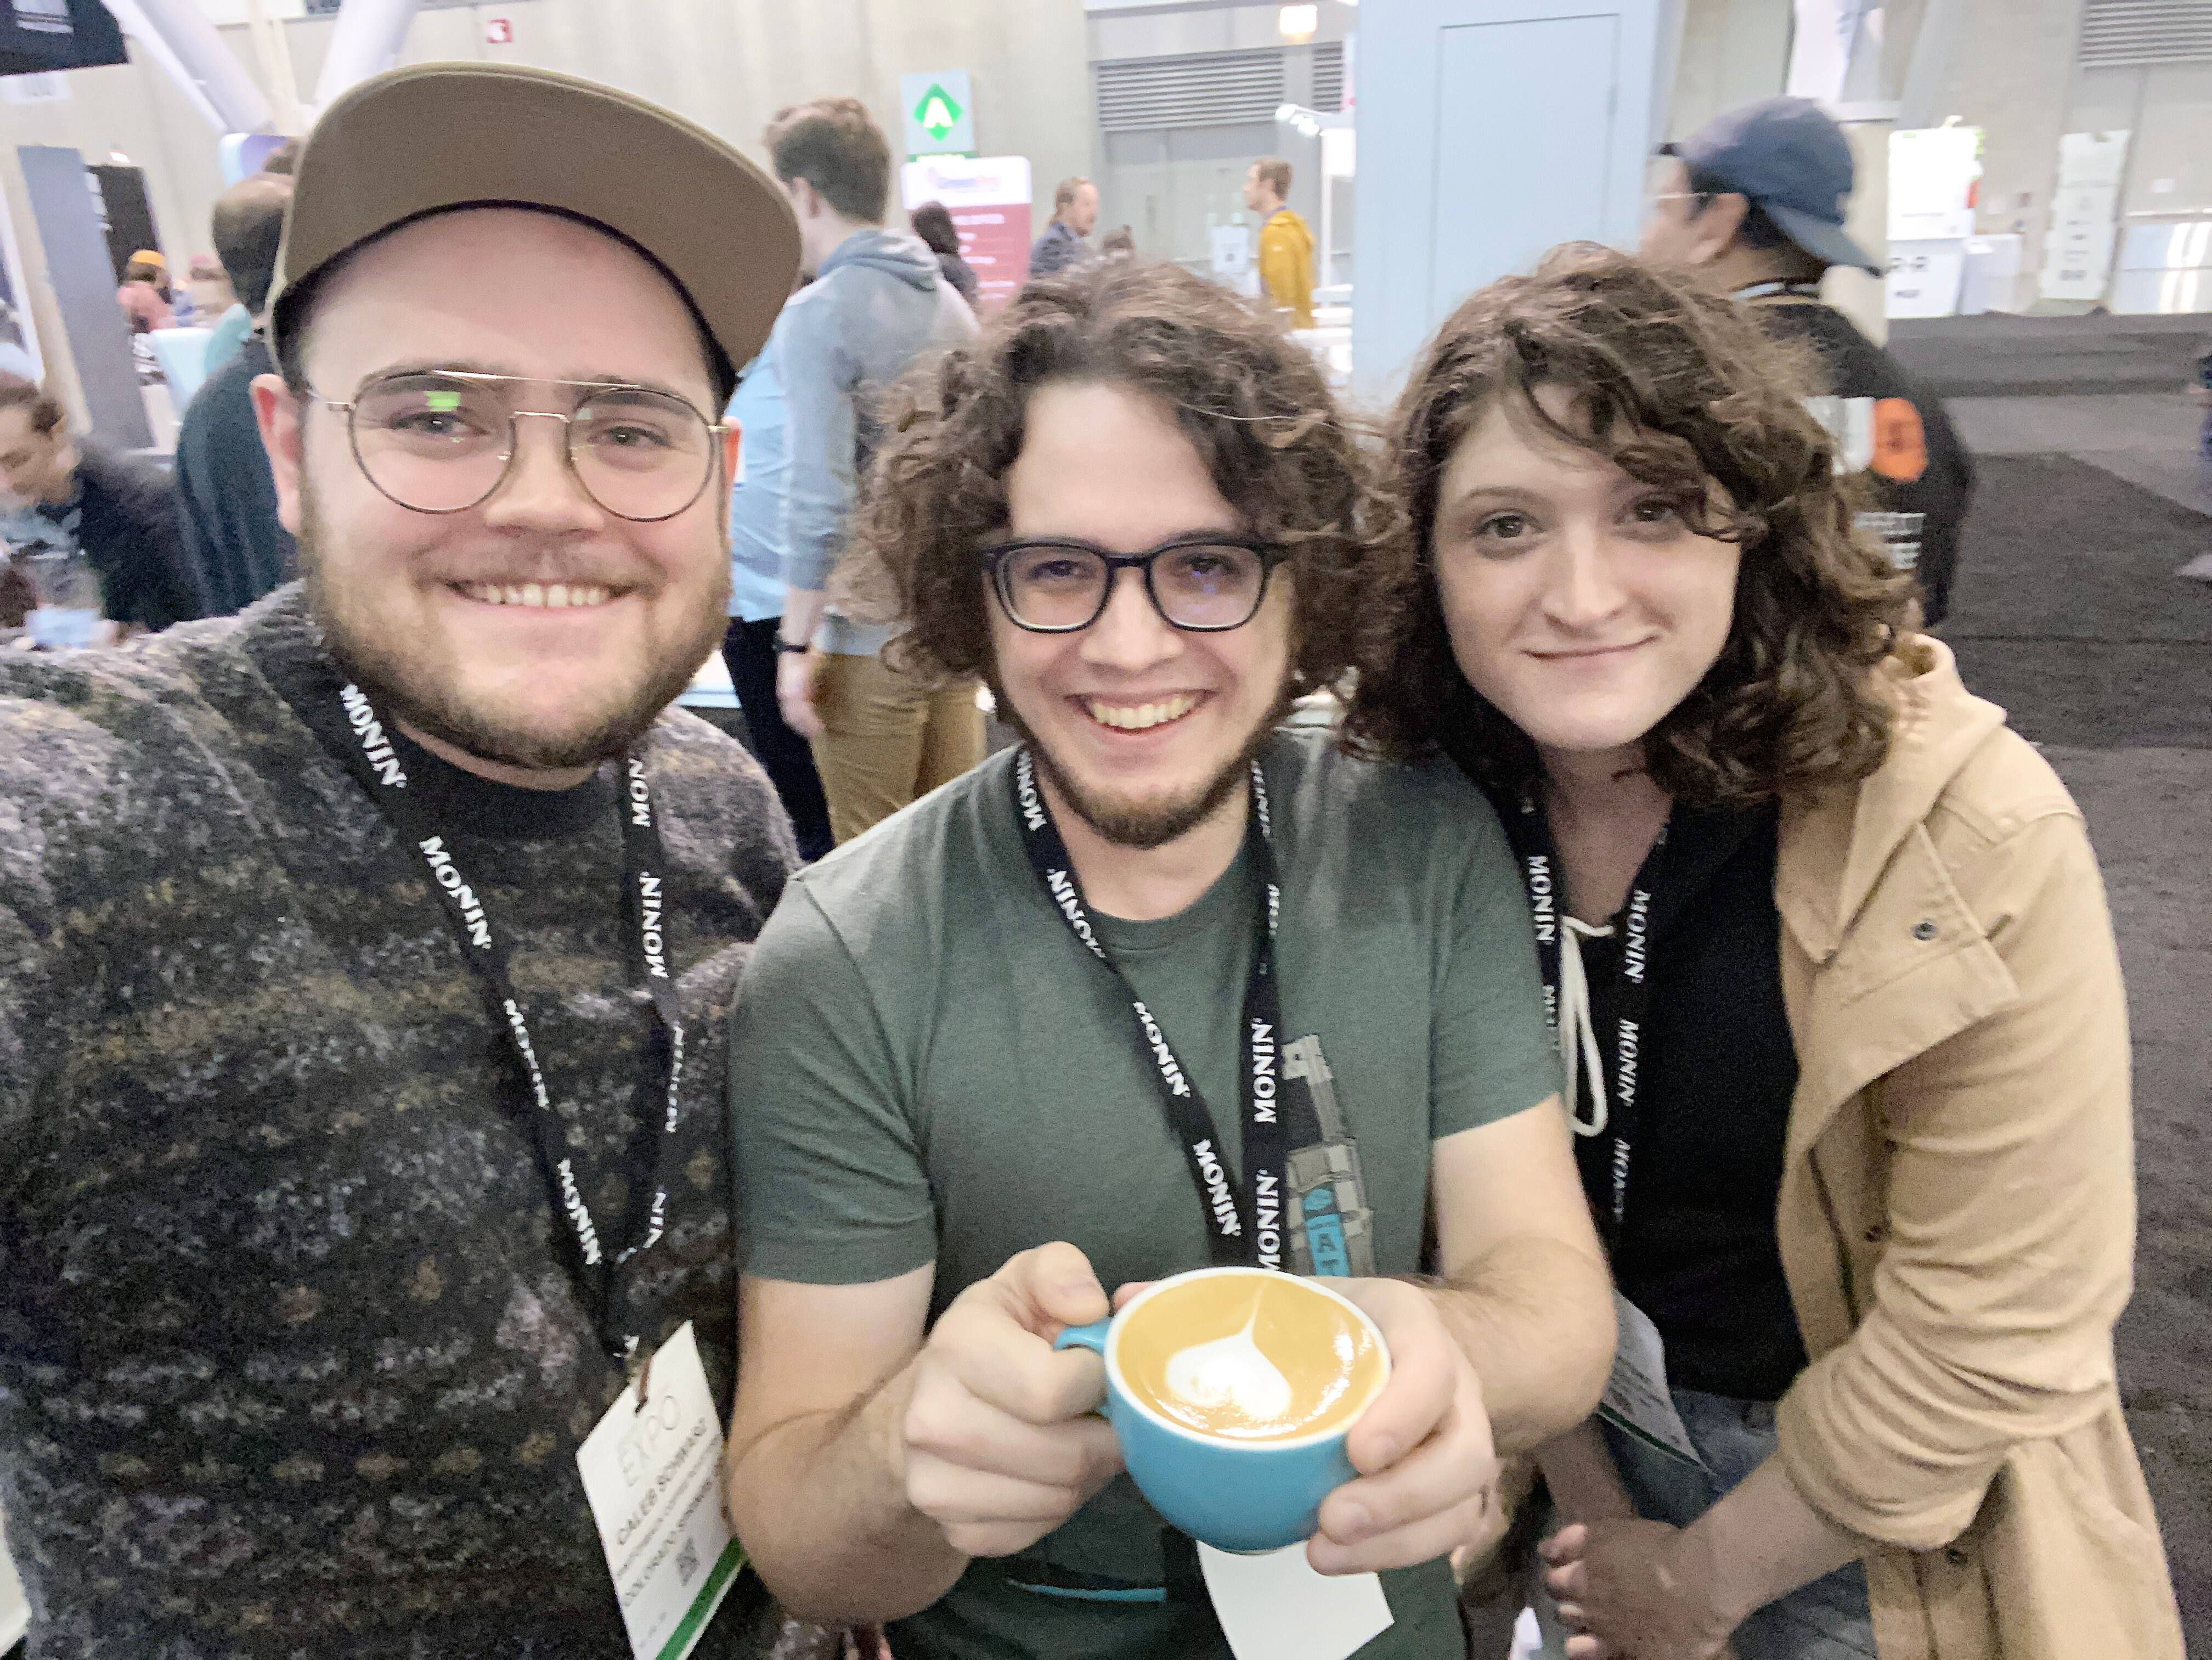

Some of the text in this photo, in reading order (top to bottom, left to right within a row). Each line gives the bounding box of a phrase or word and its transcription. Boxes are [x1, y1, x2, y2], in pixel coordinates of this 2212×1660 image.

[340, 684, 407, 787] MONIN
[629, 758, 654, 827] MON
[419, 836, 492, 949] MONIN
[639, 872, 668, 978] MONIN
[1528, 856, 1555, 941] MONIN
[1625, 890, 1651, 983] MONIN
[1133, 1002, 1190, 1098] MONIN
[1252, 1018, 1276, 1123] MONIN
[1618, 1020, 1639, 1103] MONIN
[557, 1158, 602, 1264] MONIN
[1193, 1139, 1241, 1236] MONIN
[1255, 1169, 1282, 1272] MONIN
[615, 1395, 679, 1489] EXPO
